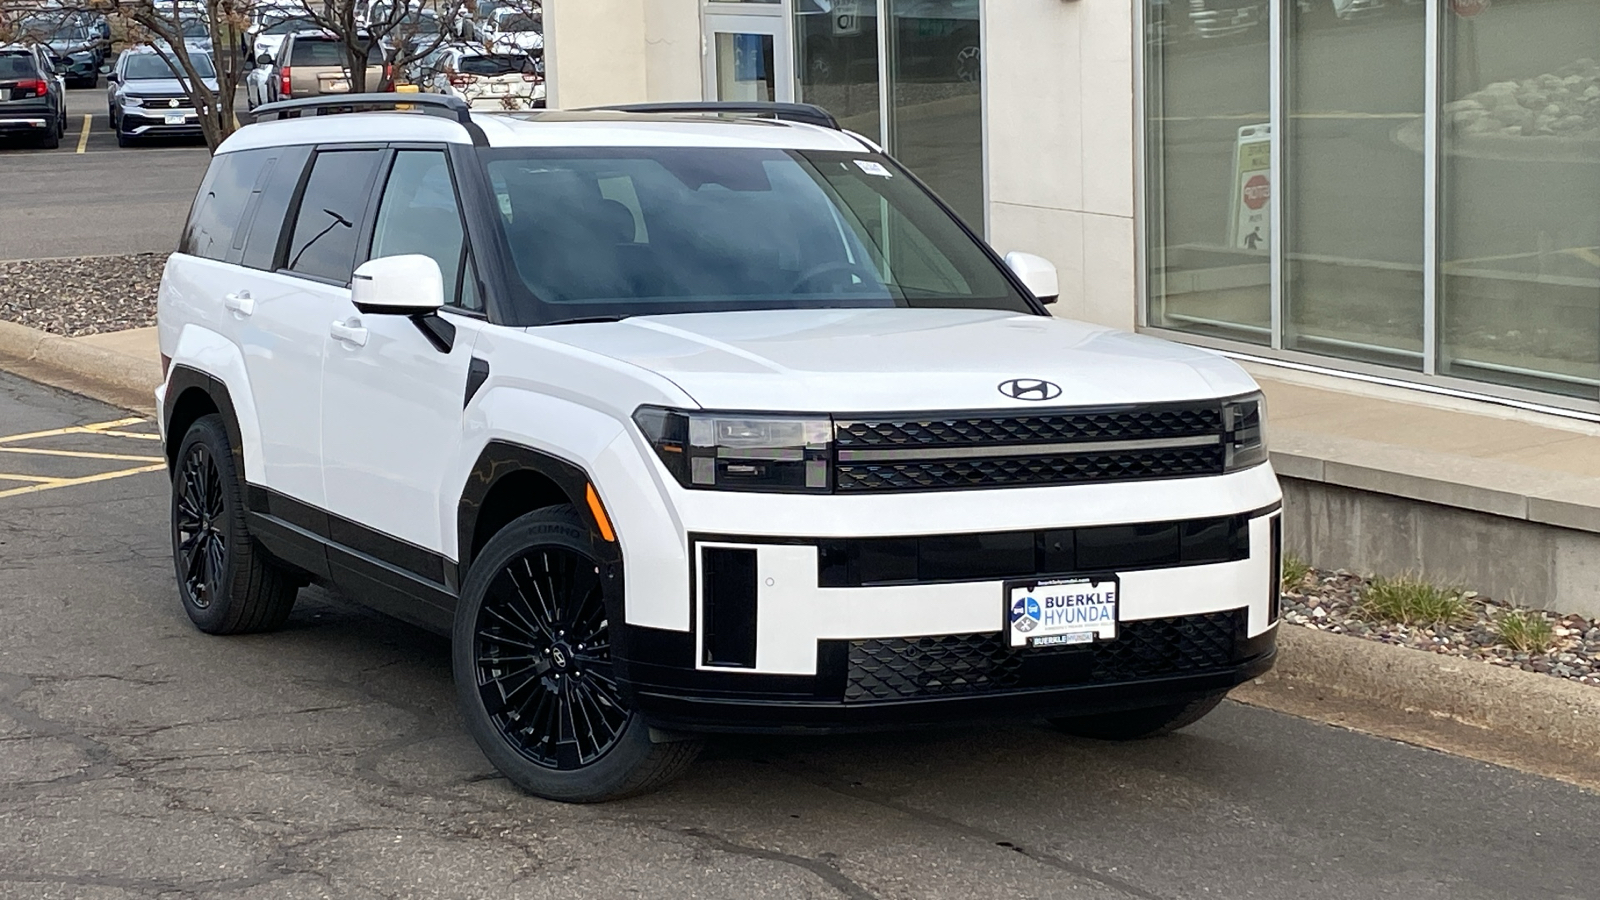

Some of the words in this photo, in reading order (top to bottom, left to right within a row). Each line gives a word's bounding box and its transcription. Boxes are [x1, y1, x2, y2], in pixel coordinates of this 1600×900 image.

[527, 524, 580, 539] KUMHO
[1045, 592, 1115, 609] BUERKLE
[1044, 605, 1115, 625] HYUNDAI
[1034, 635, 1067, 646] BUERKLE
